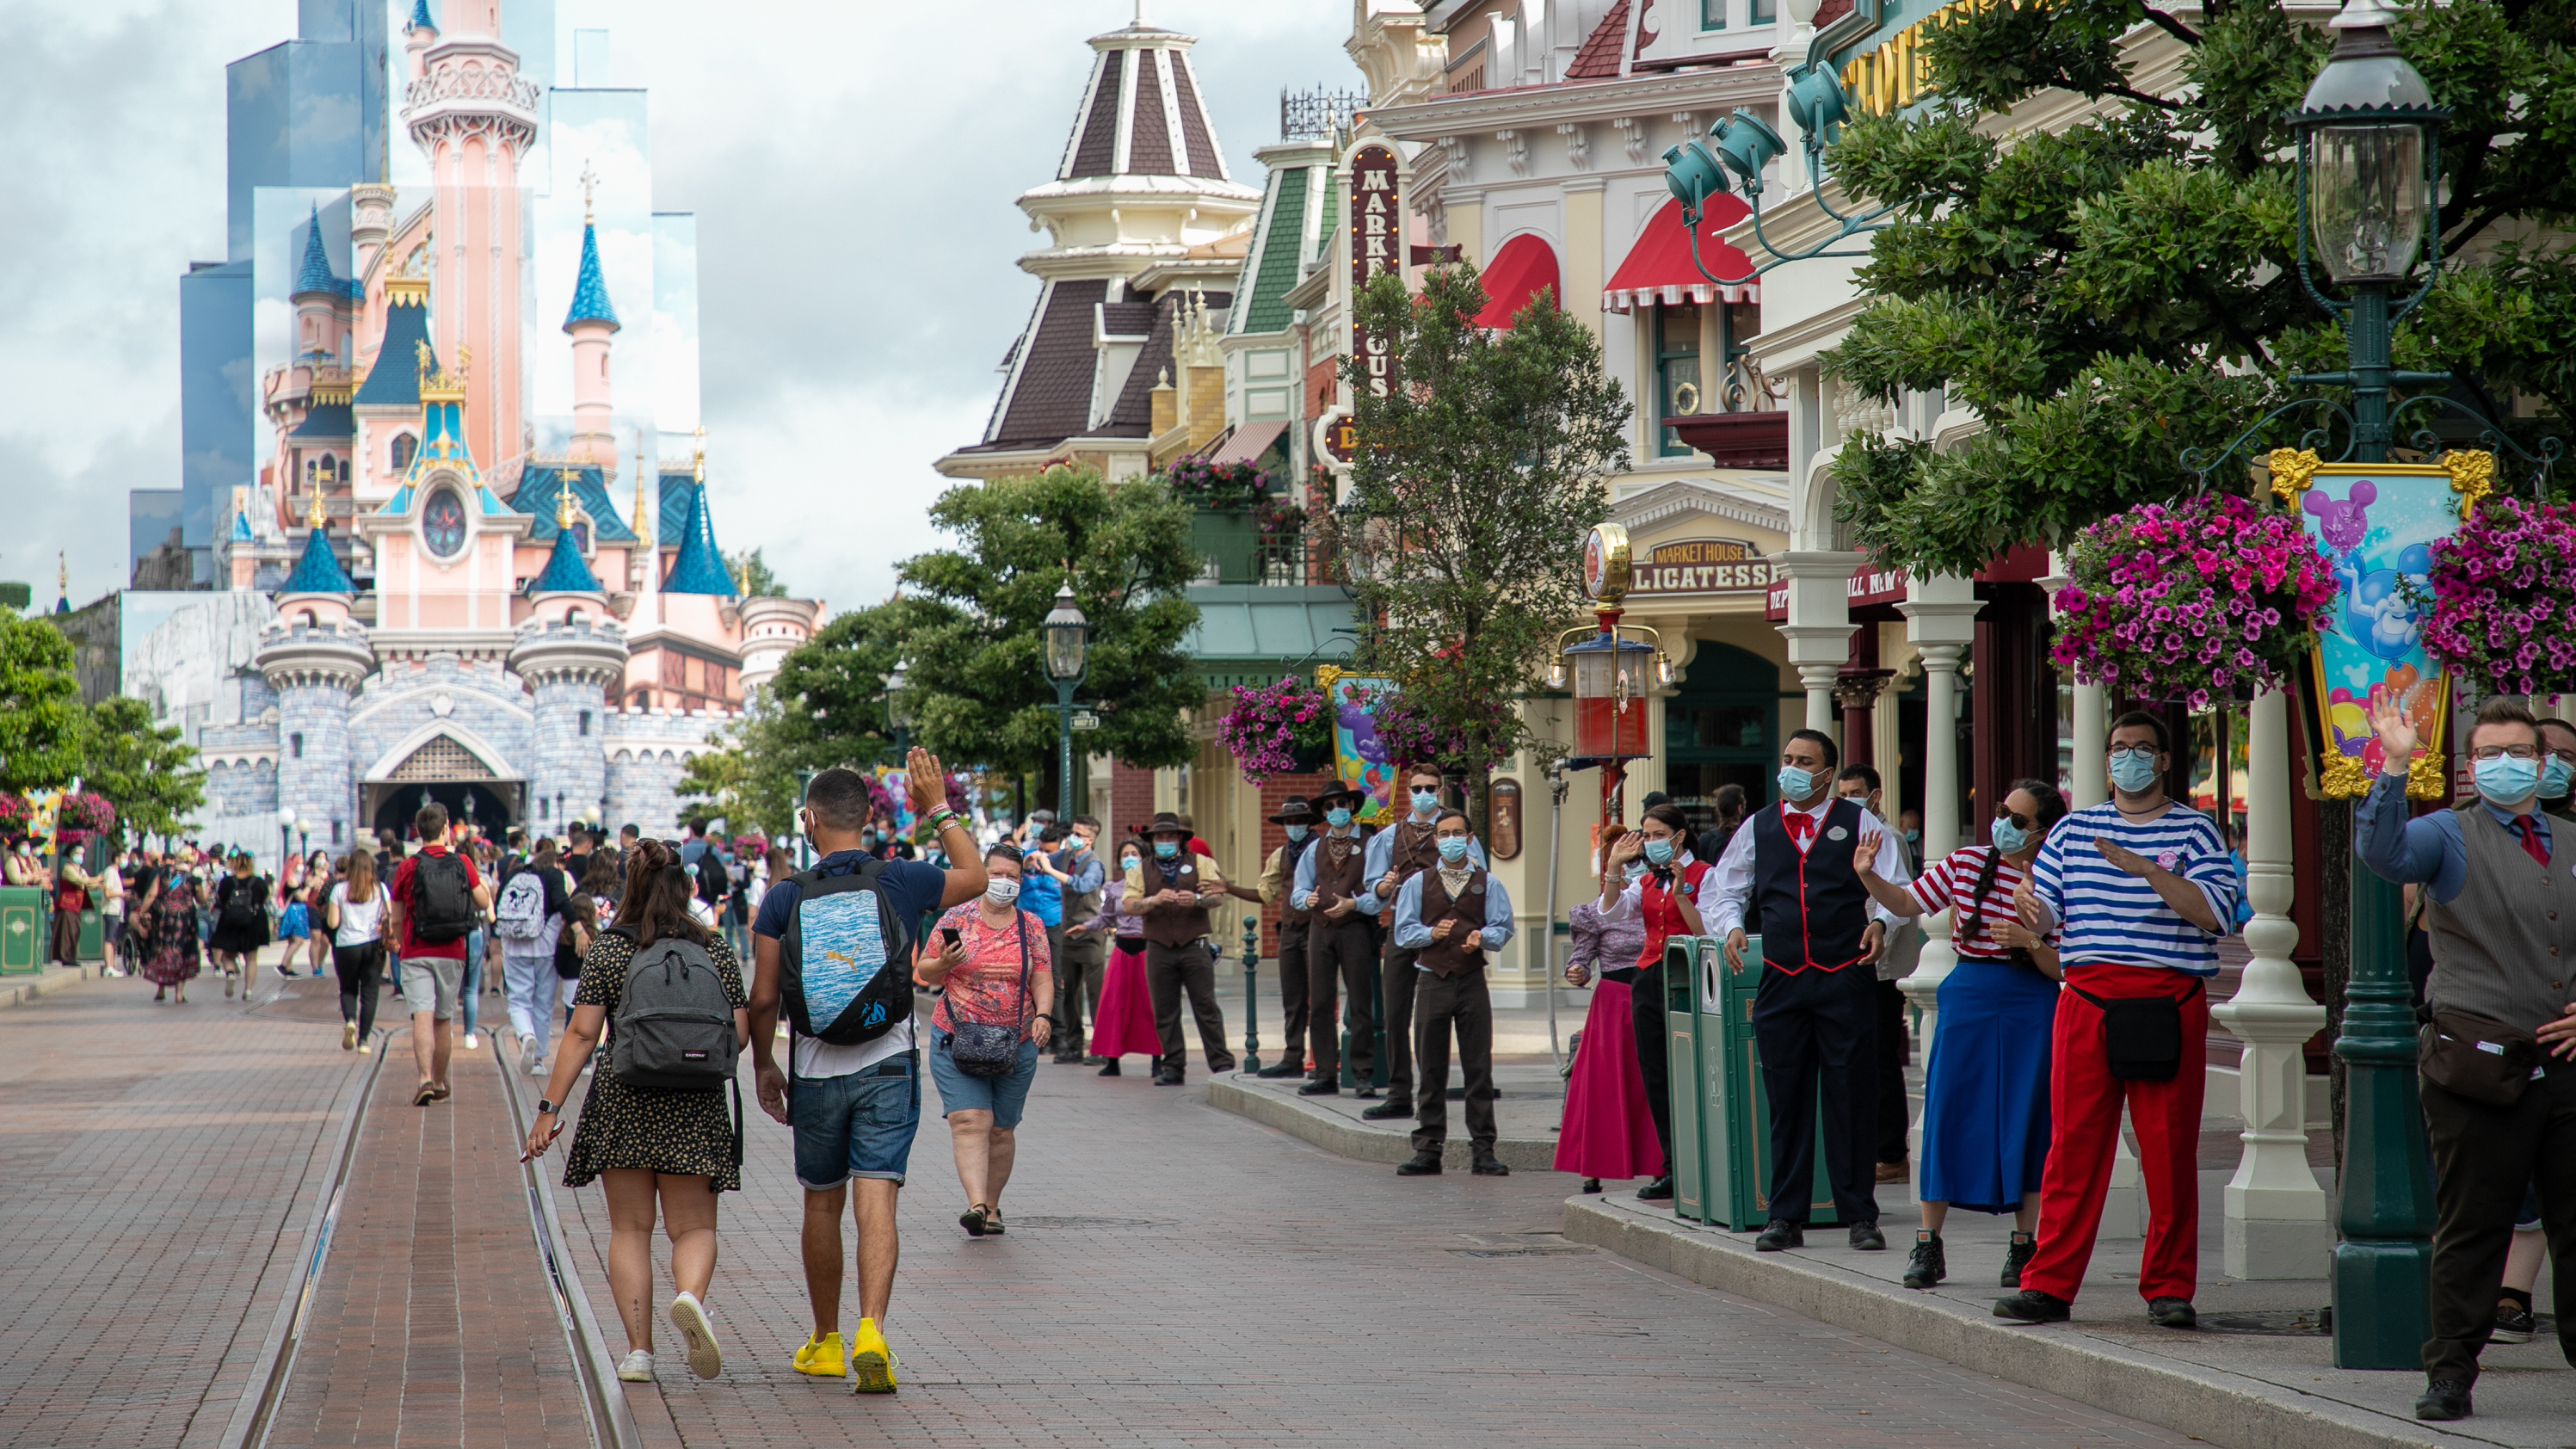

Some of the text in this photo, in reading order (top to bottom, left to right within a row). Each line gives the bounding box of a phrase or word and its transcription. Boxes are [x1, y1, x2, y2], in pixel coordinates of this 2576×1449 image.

[1361, 170, 1390, 288] MARKE
[1656, 544, 1744, 564] MARKET HOUSE
[1630, 564, 1784, 592] LICATESS
[1870, 570, 1896, 595] NEW
[1771, 589, 1789, 610] DEP
